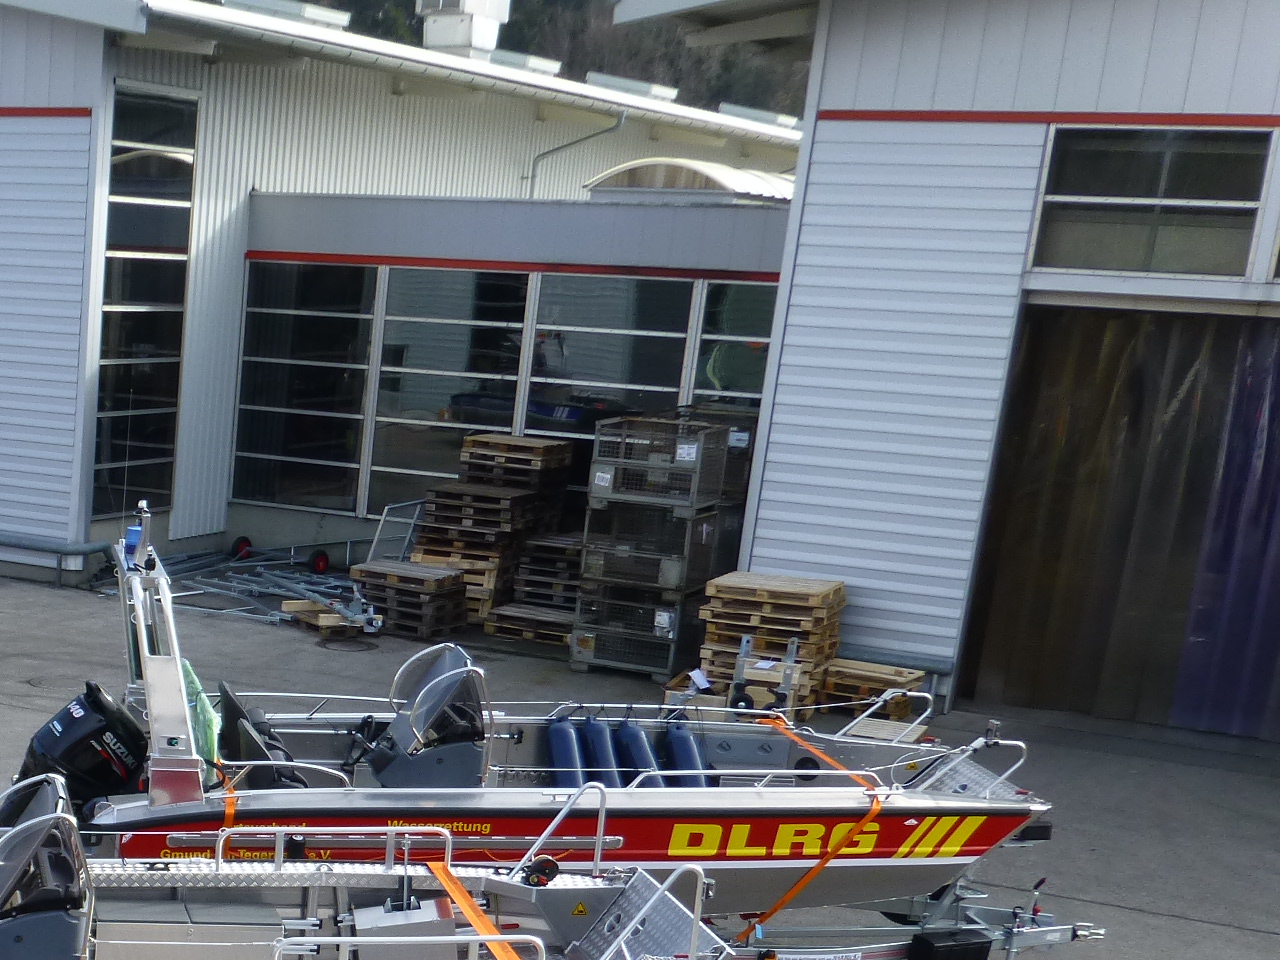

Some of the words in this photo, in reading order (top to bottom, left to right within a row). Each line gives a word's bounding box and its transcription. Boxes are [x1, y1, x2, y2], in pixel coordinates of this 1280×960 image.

[102, 731, 138, 770] SUZUKI
[160, 849, 211, 859] Gmund
[667, 822, 881, 857] DLRG
